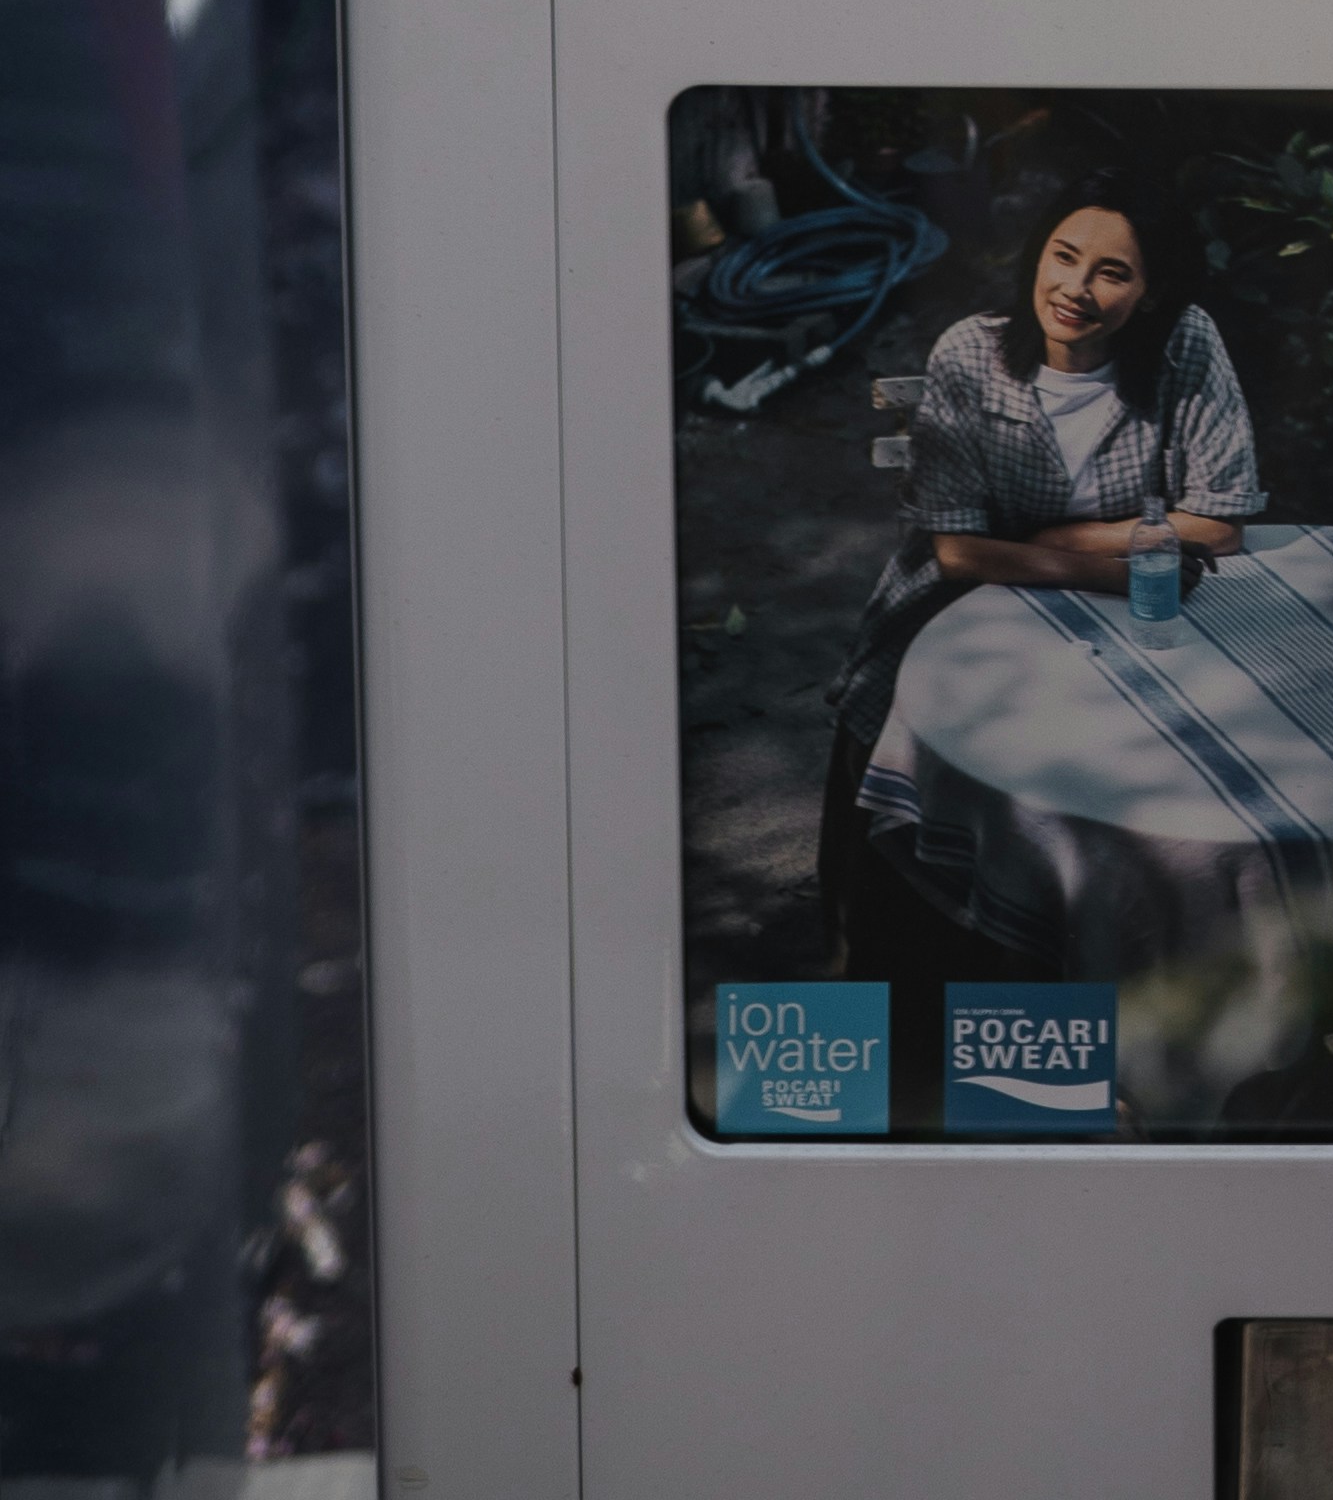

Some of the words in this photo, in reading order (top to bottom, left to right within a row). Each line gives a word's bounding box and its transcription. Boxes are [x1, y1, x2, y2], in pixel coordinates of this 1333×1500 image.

[729, 994, 804, 1036] ion
[954, 1019, 1108, 1045] POCARI
[727, 1033, 879, 1072] water
[954, 1046, 1095, 1070] SWEAT
[762, 1081, 841, 1093] POCARI
[762, 1094, 834, 1106] SWEAT
